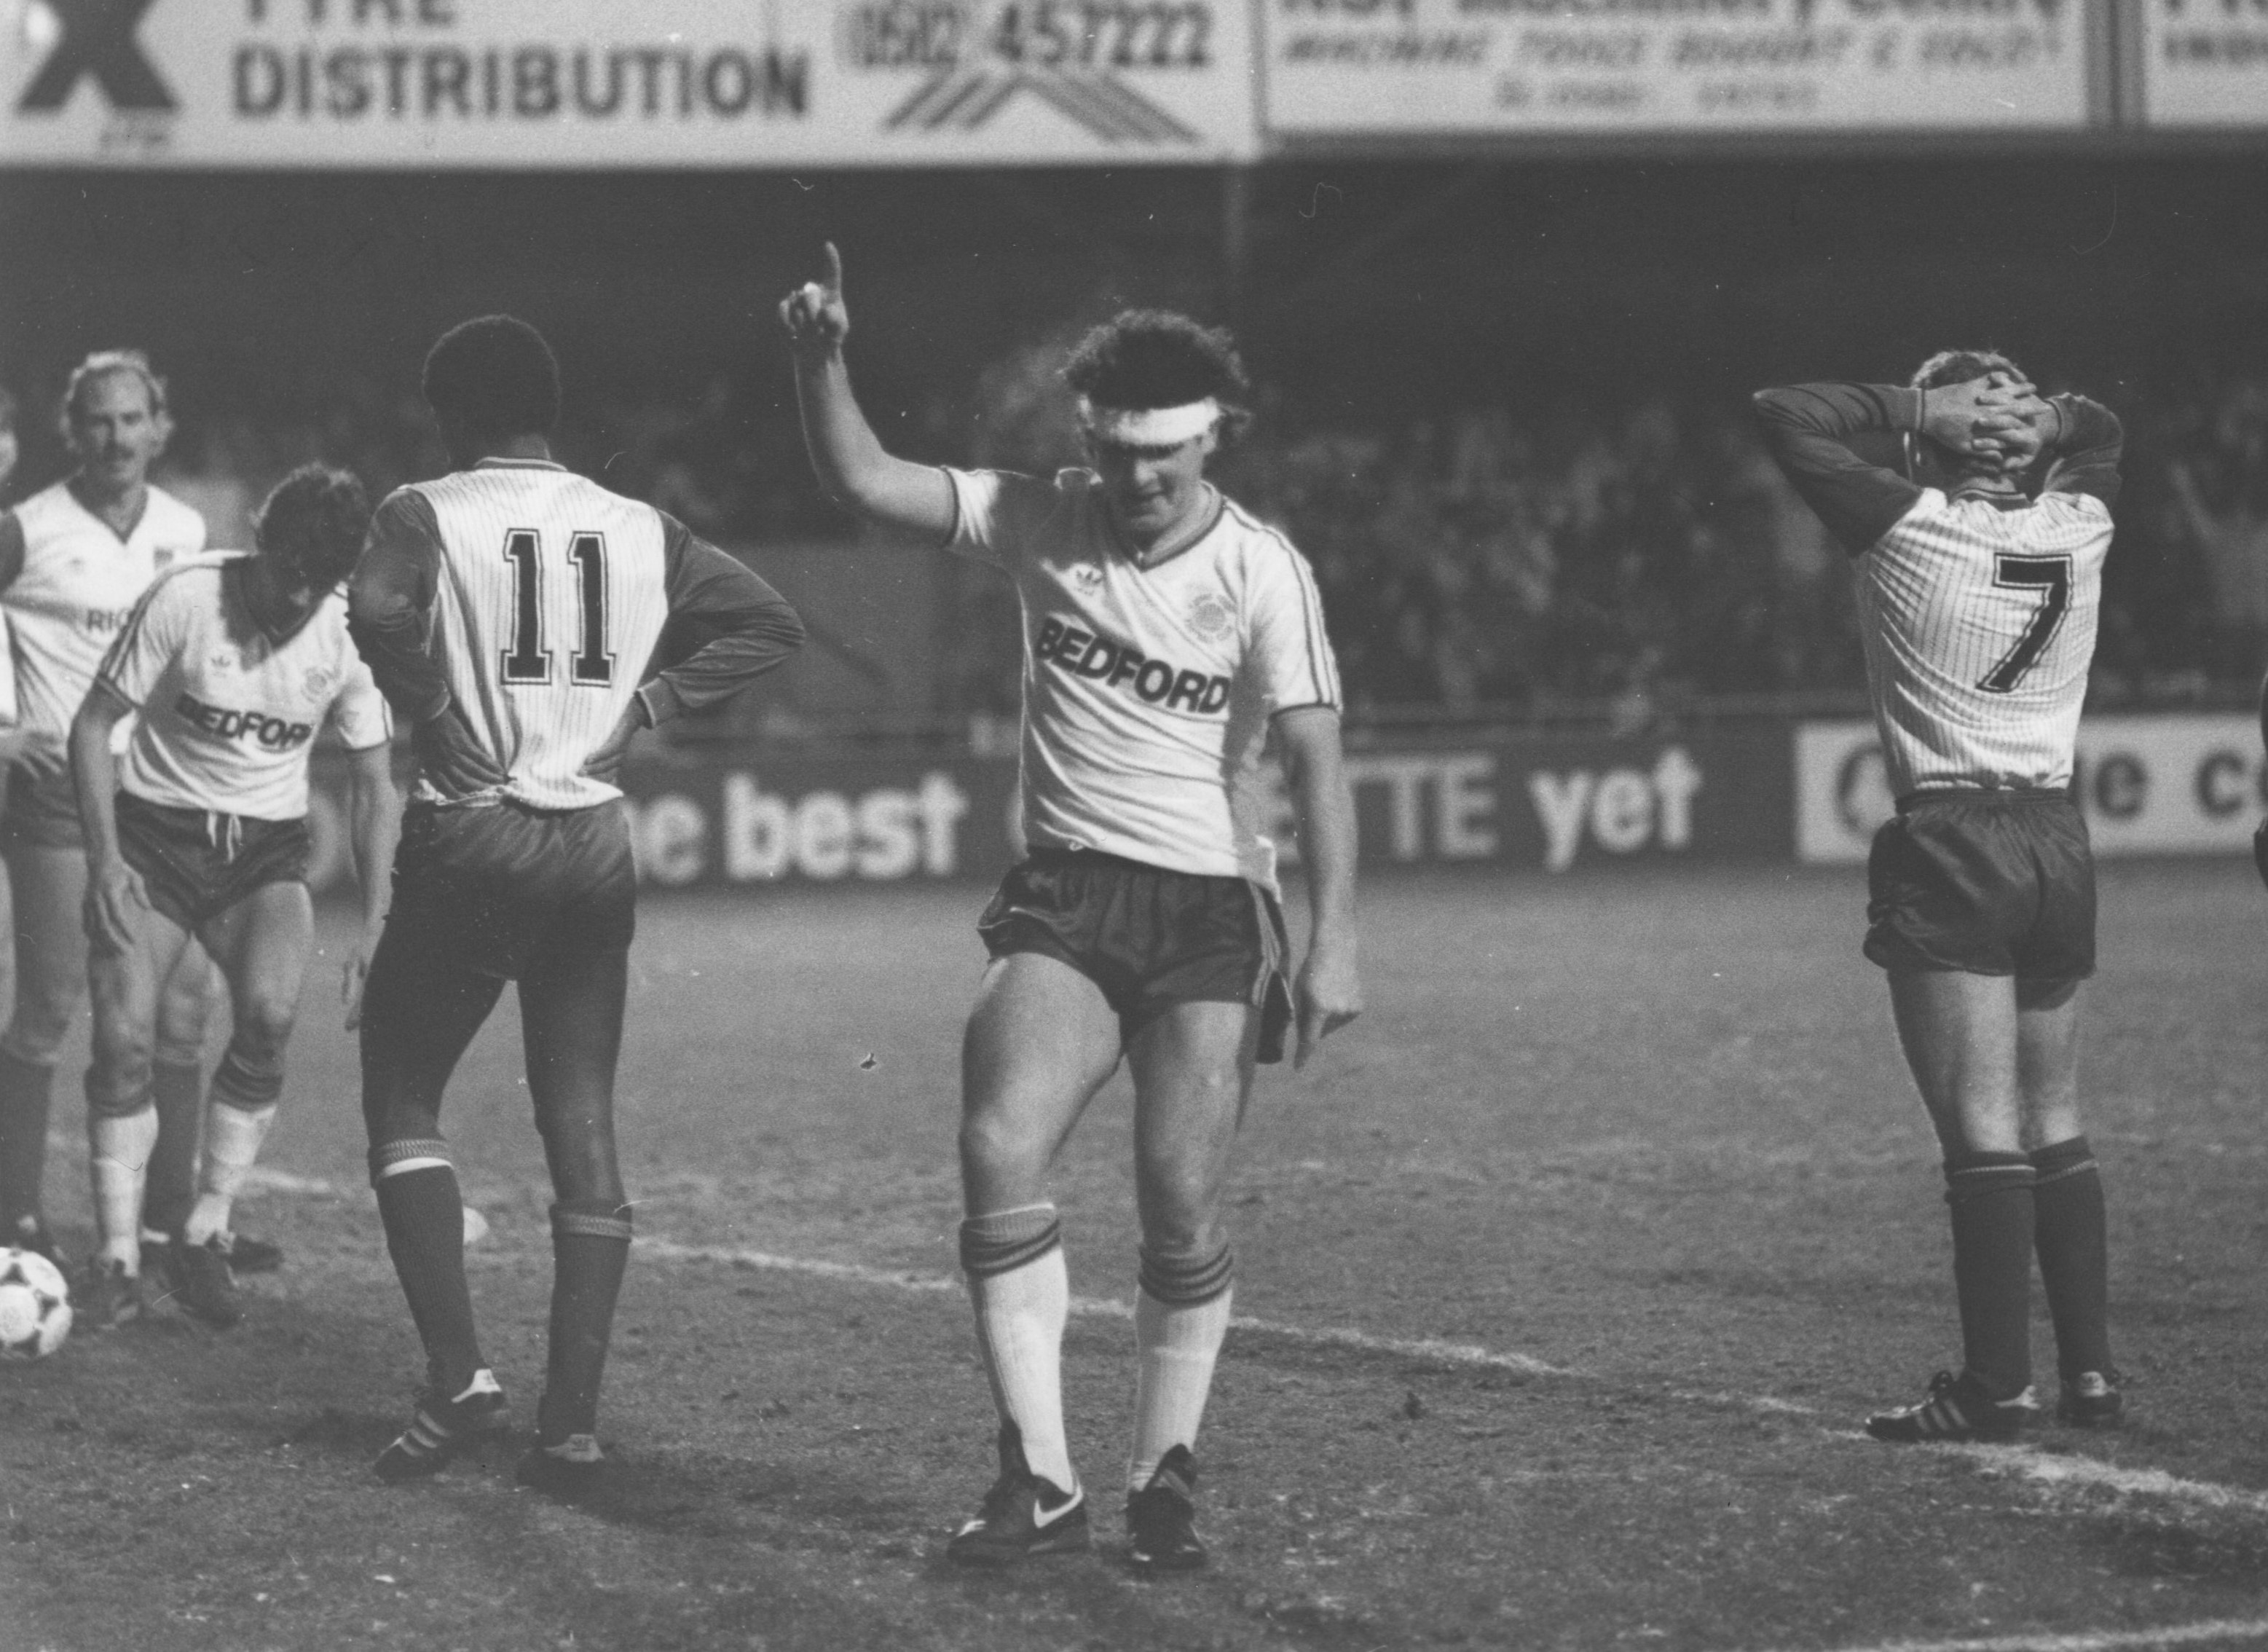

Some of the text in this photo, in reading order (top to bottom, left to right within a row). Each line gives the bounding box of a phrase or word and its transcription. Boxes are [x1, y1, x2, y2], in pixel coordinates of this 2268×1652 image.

[235, 44, 808, 119] DISTRIBUTION
[500, 527, 617, 688] 11
[1034, 619, 1231, 715] BEDFORD
[1975, 552, 2074, 693] 7
[725, 768, 970, 880] best
[1529, 744, 1703, 873] yet
